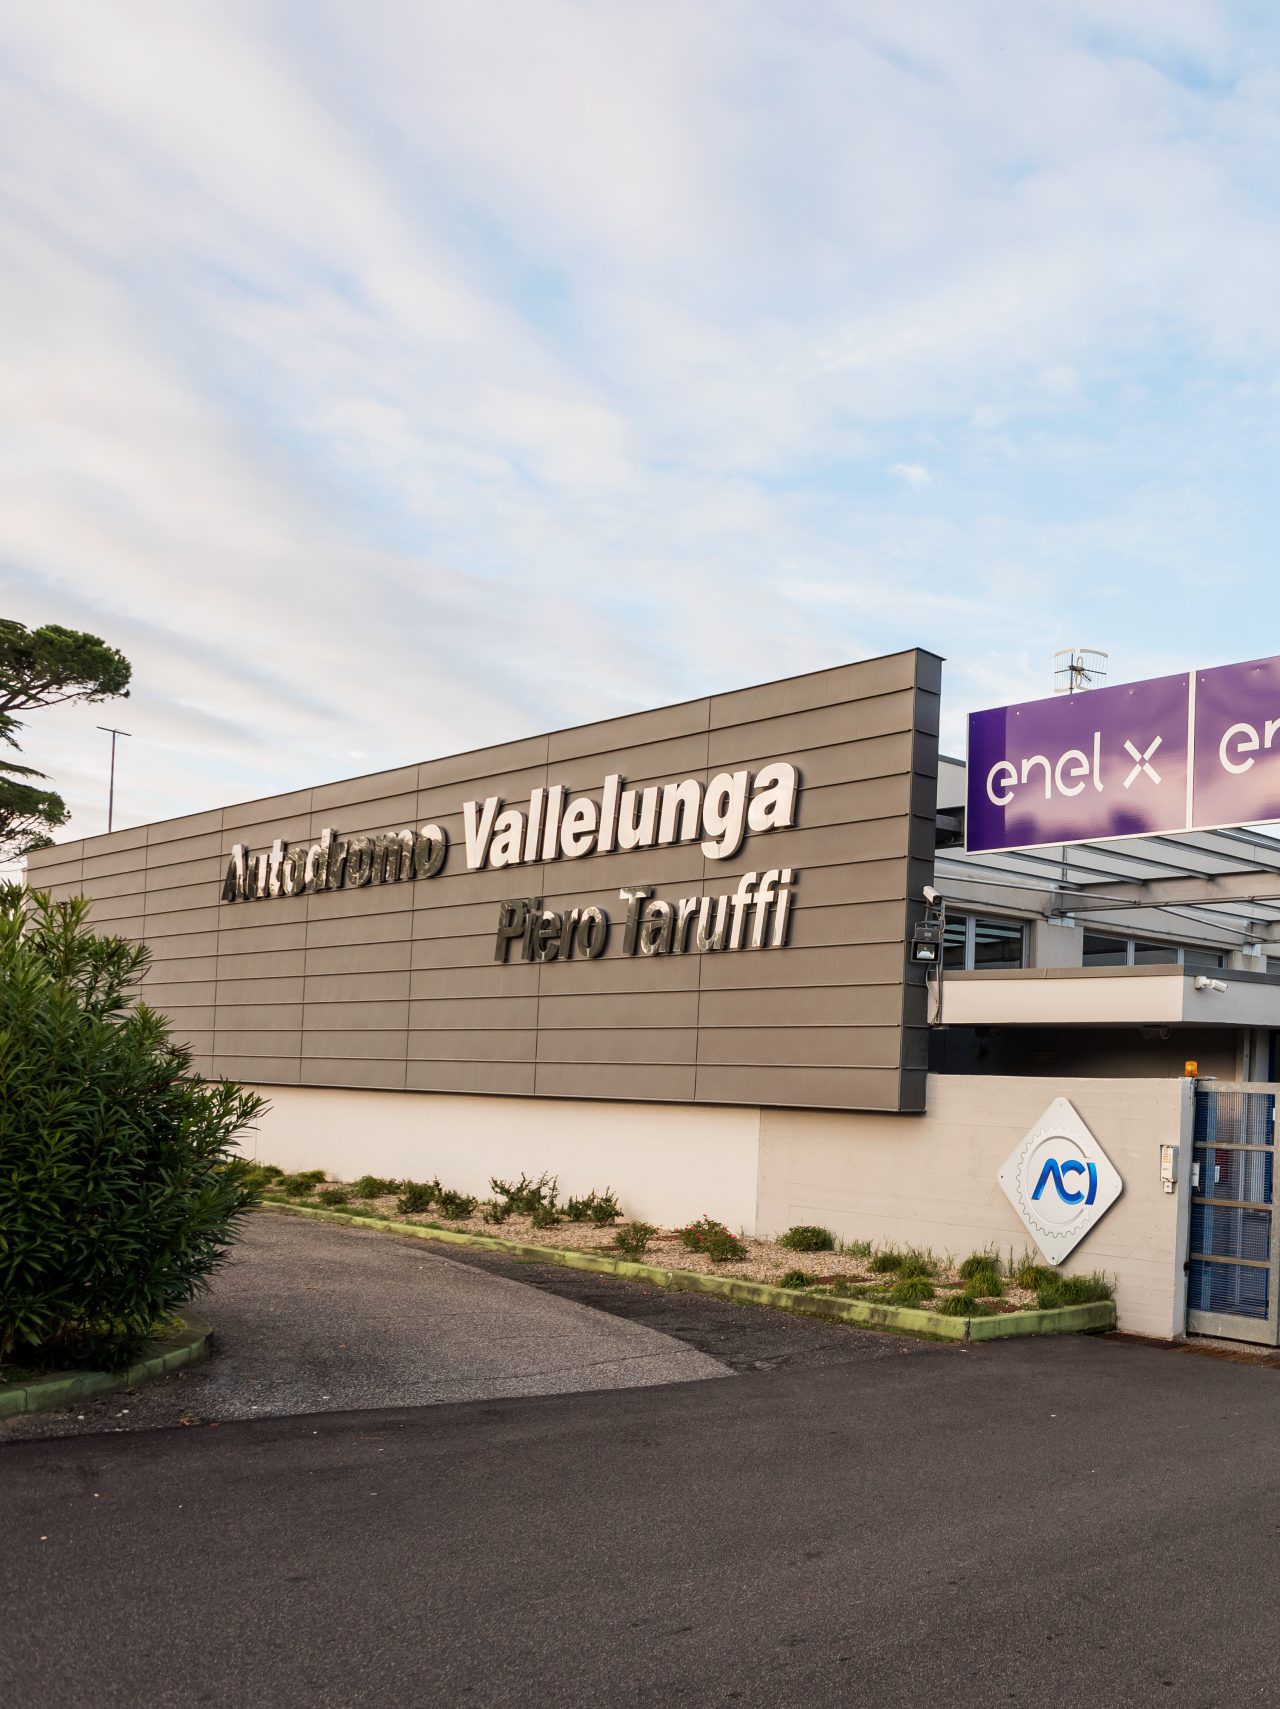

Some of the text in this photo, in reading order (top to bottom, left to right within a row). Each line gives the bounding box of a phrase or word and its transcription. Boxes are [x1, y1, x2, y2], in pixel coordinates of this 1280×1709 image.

[986, 731, 1104, 806] enel
[221, 761, 801, 902] Autodromo Vallelunga
[494, 867, 795, 962] Piero Taruffi
[1031, 1157, 1098, 1206] ACI
